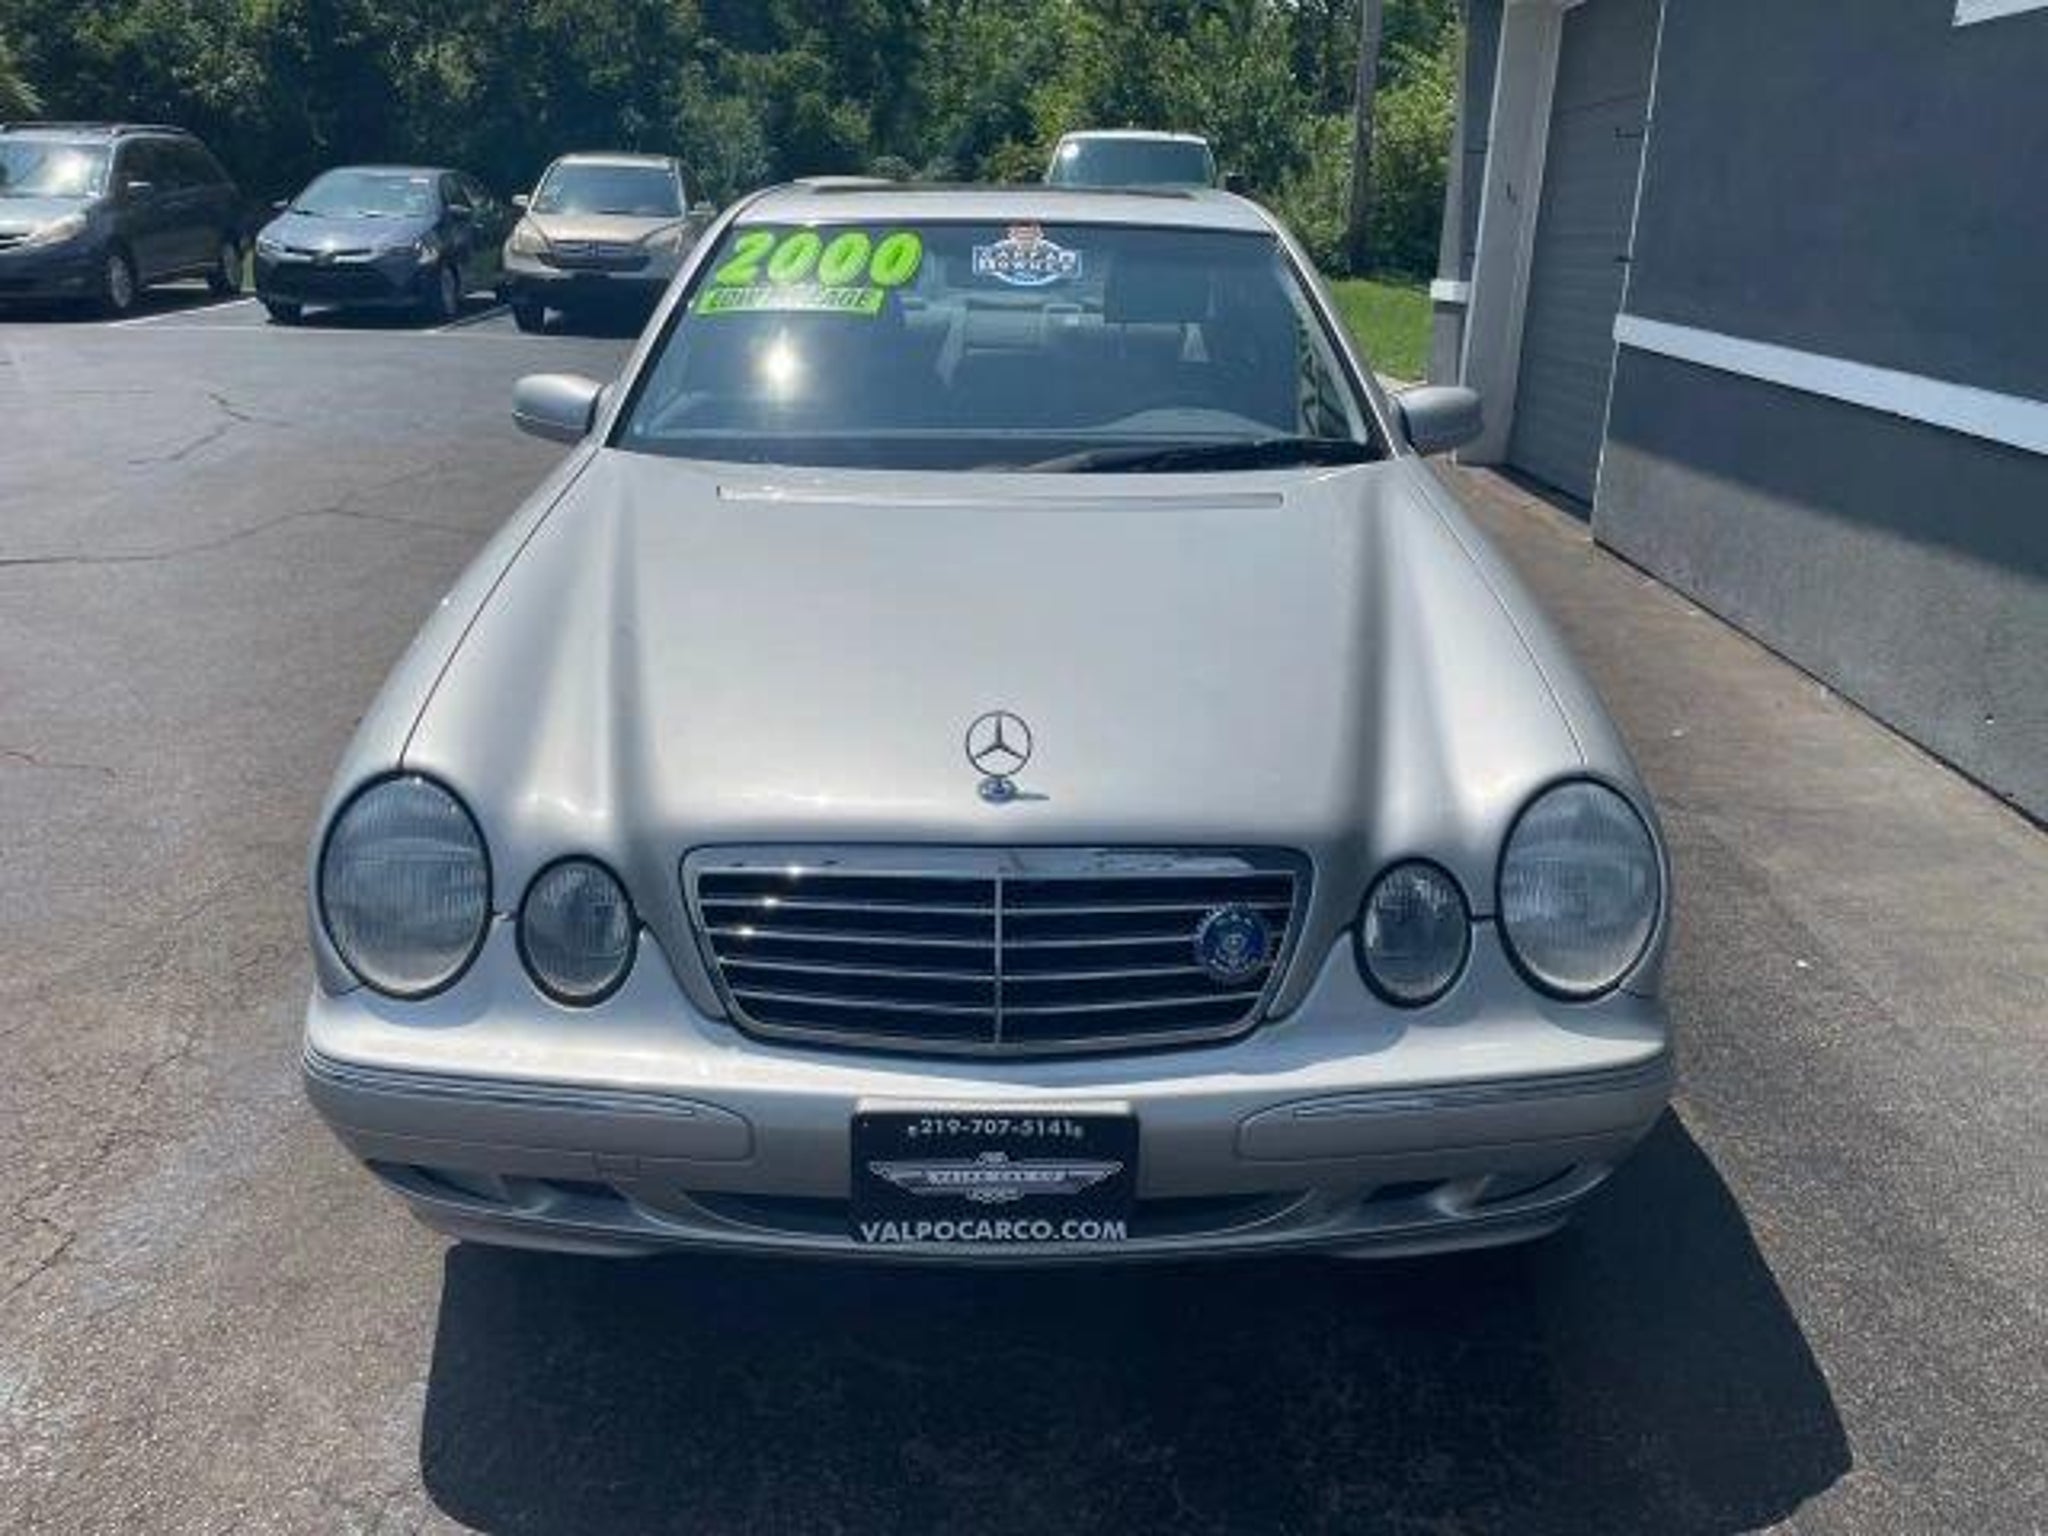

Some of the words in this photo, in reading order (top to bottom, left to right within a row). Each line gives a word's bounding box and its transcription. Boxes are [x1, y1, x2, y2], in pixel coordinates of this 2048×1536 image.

[716, 230, 922, 286] 2000
[920, 1119, 1073, 1138] 219-707-5141
[861, 1219, 1128, 1241] VALPOCARCO.COM
